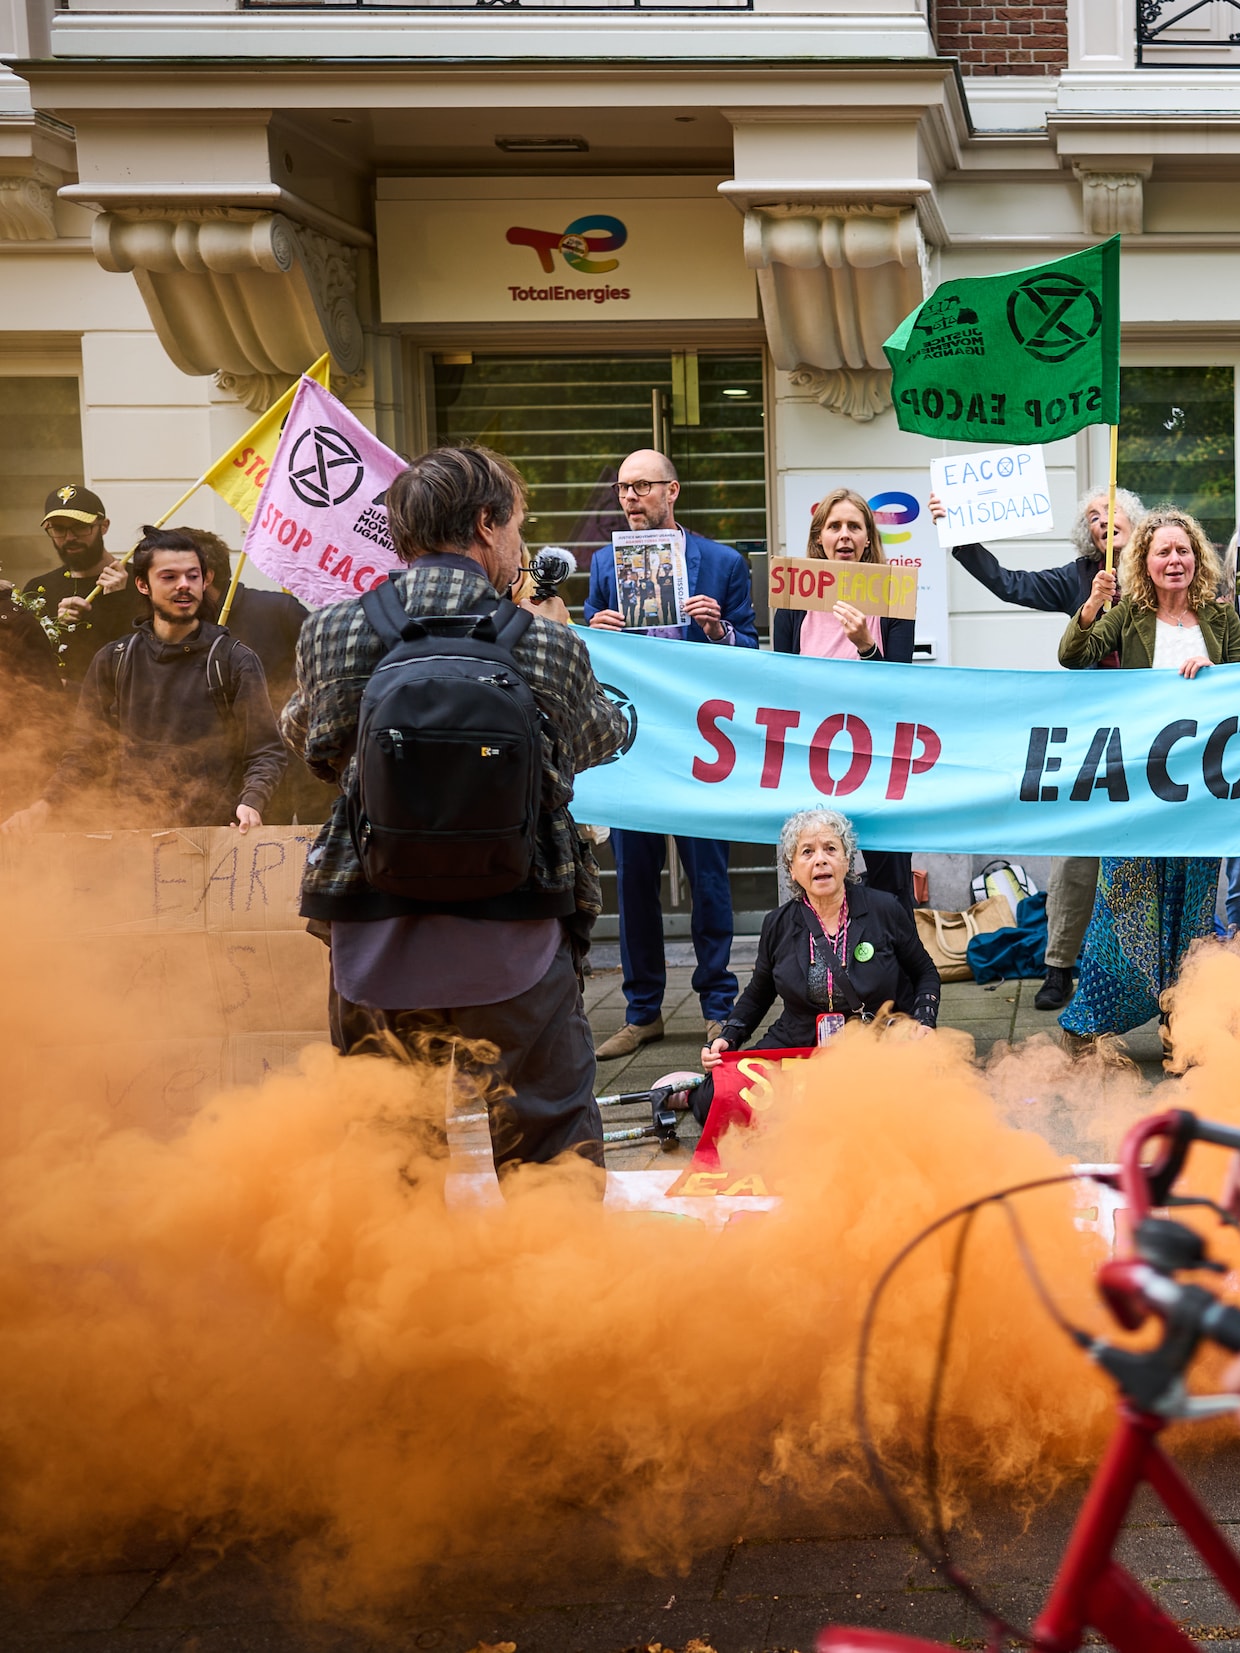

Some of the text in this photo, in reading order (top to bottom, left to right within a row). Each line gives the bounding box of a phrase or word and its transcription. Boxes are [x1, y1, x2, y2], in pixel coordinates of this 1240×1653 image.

[507, 285, 631, 304] TotalEnergies
[233, 447, 271, 488] STO
[944, 453, 1031, 486] EACOP
[353, 523, 398, 554] UGAND
[357, 514, 394, 540] MOVE
[261, 503, 389, 593] STOP EAC
[771, 566, 916, 607] STOP EACOP
[691, 699, 942, 801] STOP
[153, 835, 313, 913] EART
